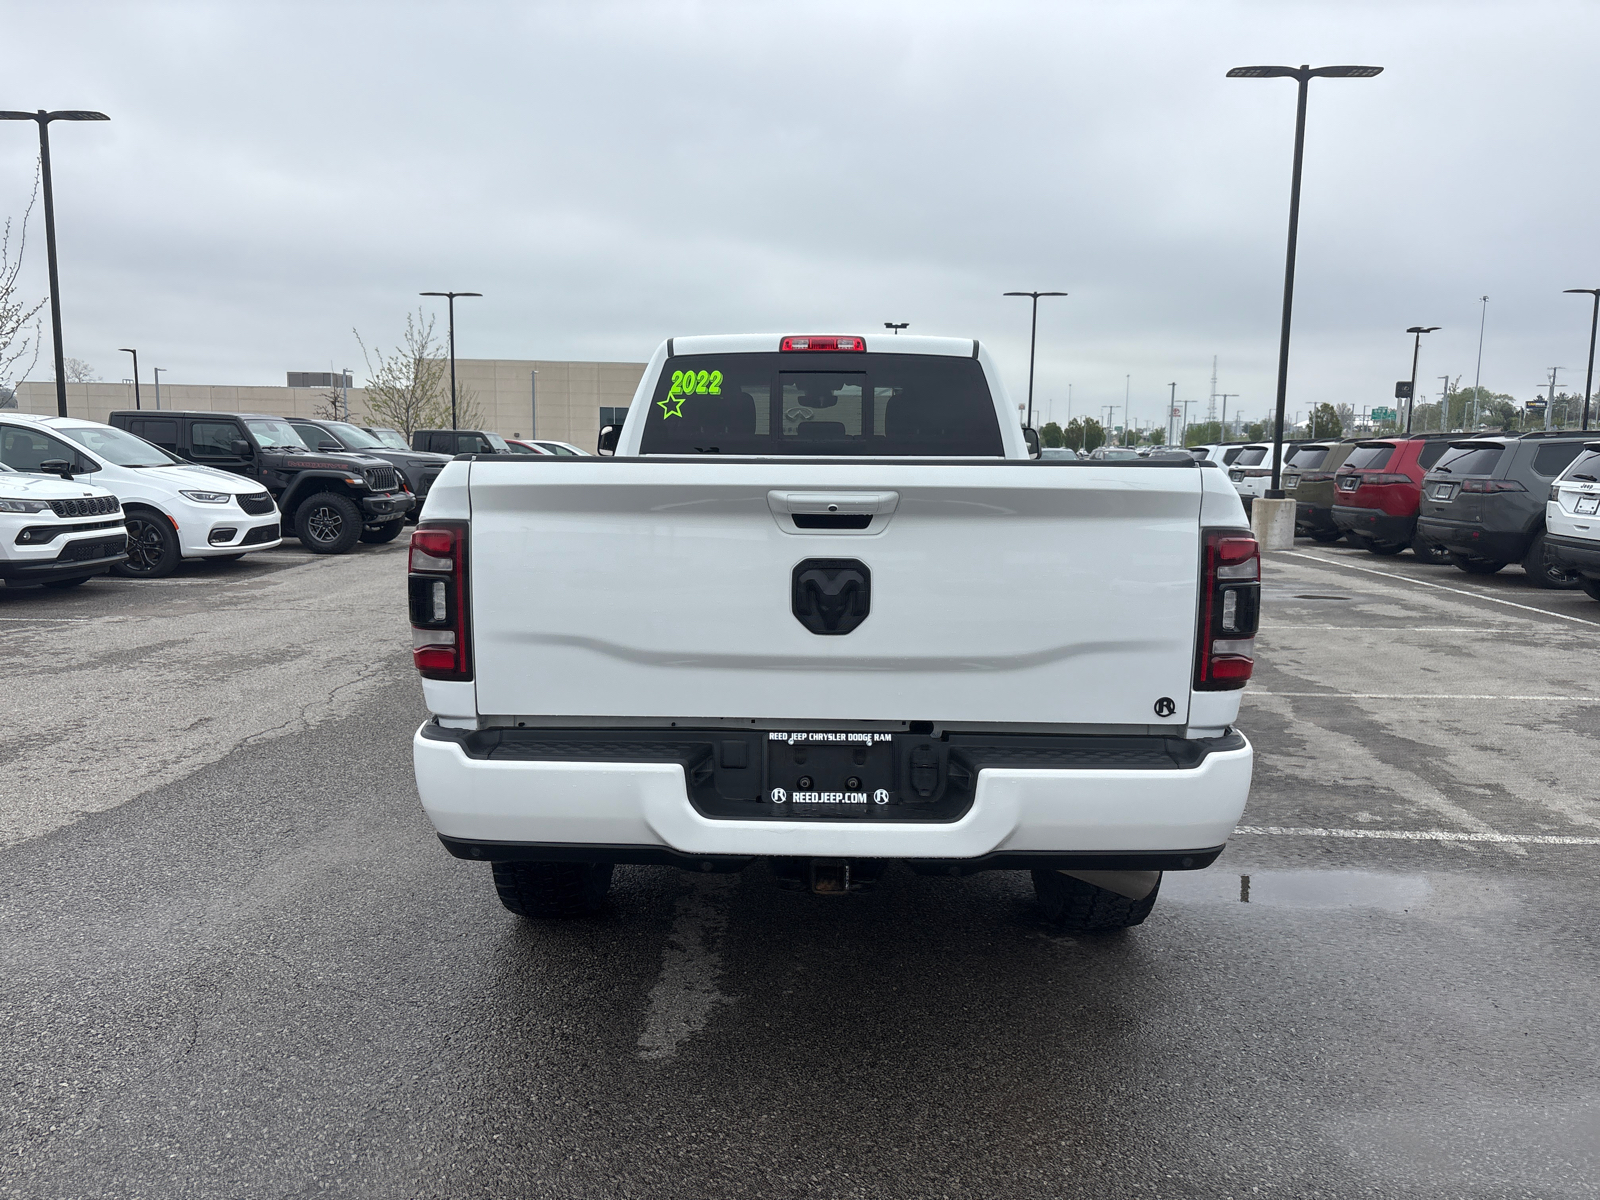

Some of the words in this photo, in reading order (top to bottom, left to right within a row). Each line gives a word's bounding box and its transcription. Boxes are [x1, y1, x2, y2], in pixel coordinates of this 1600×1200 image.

[671, 370, 723, 395] 2022
[769, 732, 788, 740] REED
[789, 733, 807, 741] JEEP
[808, 733, 846, 741] CHRYSLER
[847, 733, 872, 741] DODGE
[873, 733, 892, 742] RAM
[792, 792, 867, 804] REEDJEEP.COM
